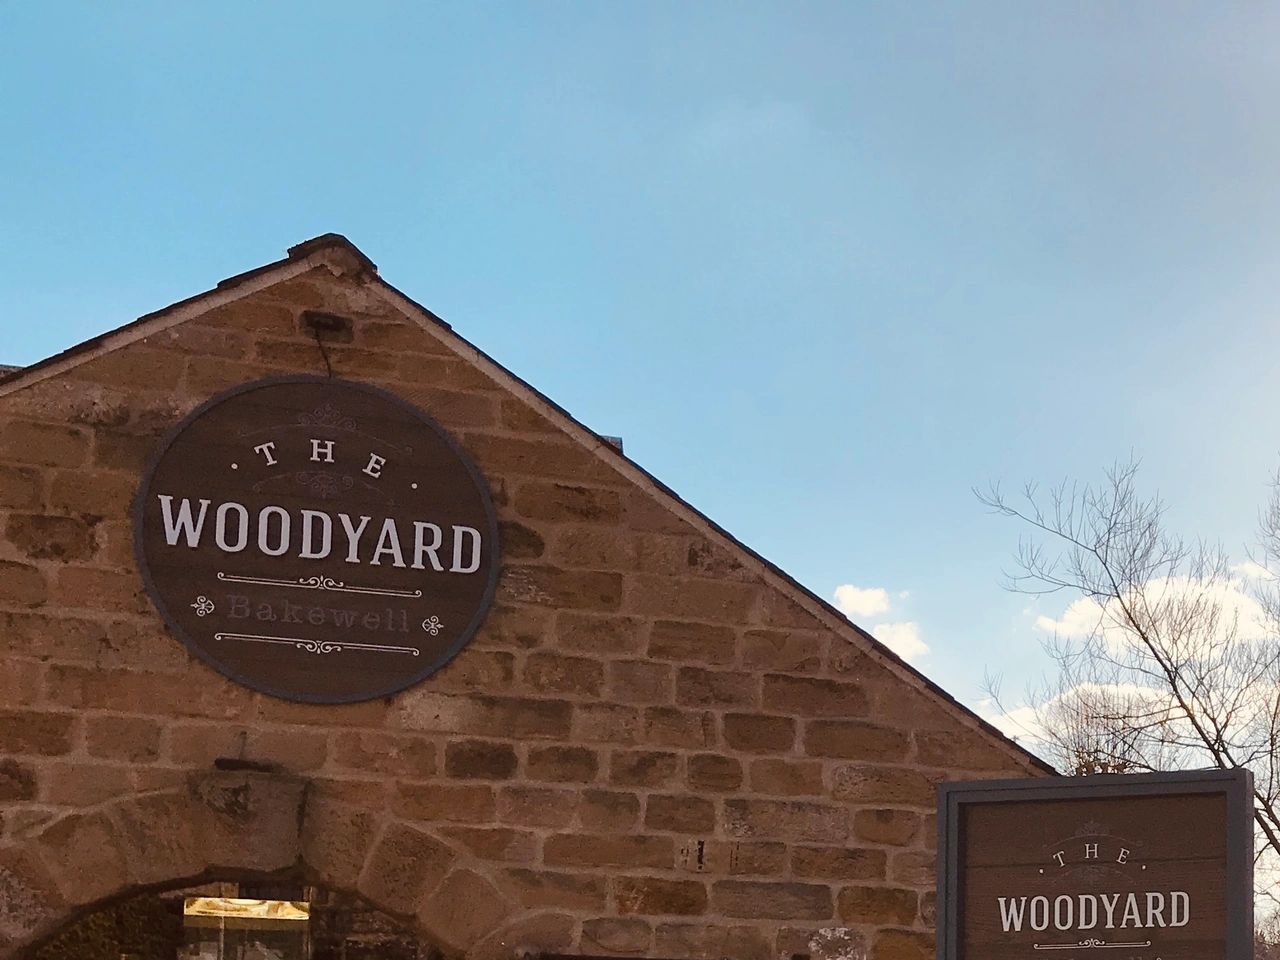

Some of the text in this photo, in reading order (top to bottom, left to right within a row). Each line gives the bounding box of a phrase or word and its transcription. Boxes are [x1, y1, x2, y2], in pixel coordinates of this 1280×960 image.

[254, 439, 386, 479] THE
[157, 494, 482, 574] WOODYARD
[226, 594, 411, 633] Bakewell
[1053, 843, 1130, 868] THE
[998, 891, 1191, 932] WOODYARD
